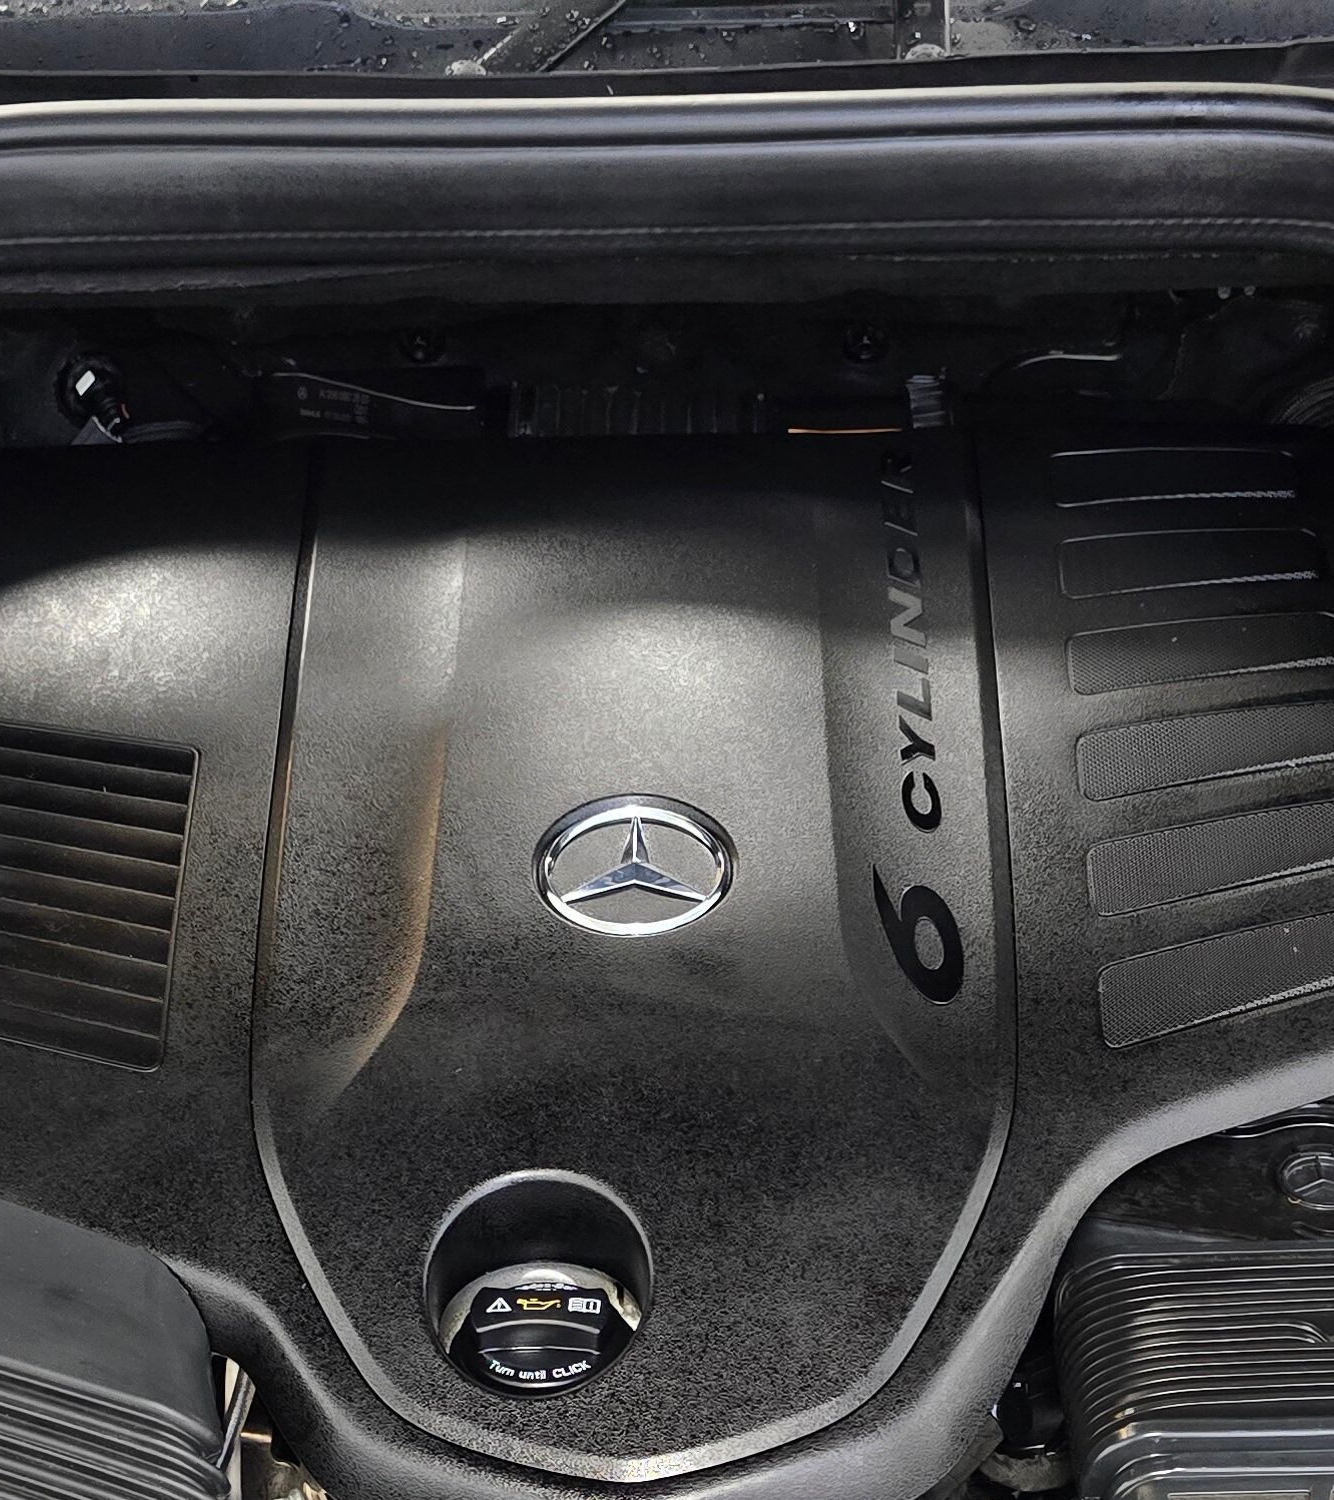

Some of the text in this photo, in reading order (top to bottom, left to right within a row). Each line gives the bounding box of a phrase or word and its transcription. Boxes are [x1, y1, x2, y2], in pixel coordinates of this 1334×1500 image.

[872, 450, 965, 1005] 6 CYLINDER
[488, 1359, 592, 1380] Turn until CLICK
